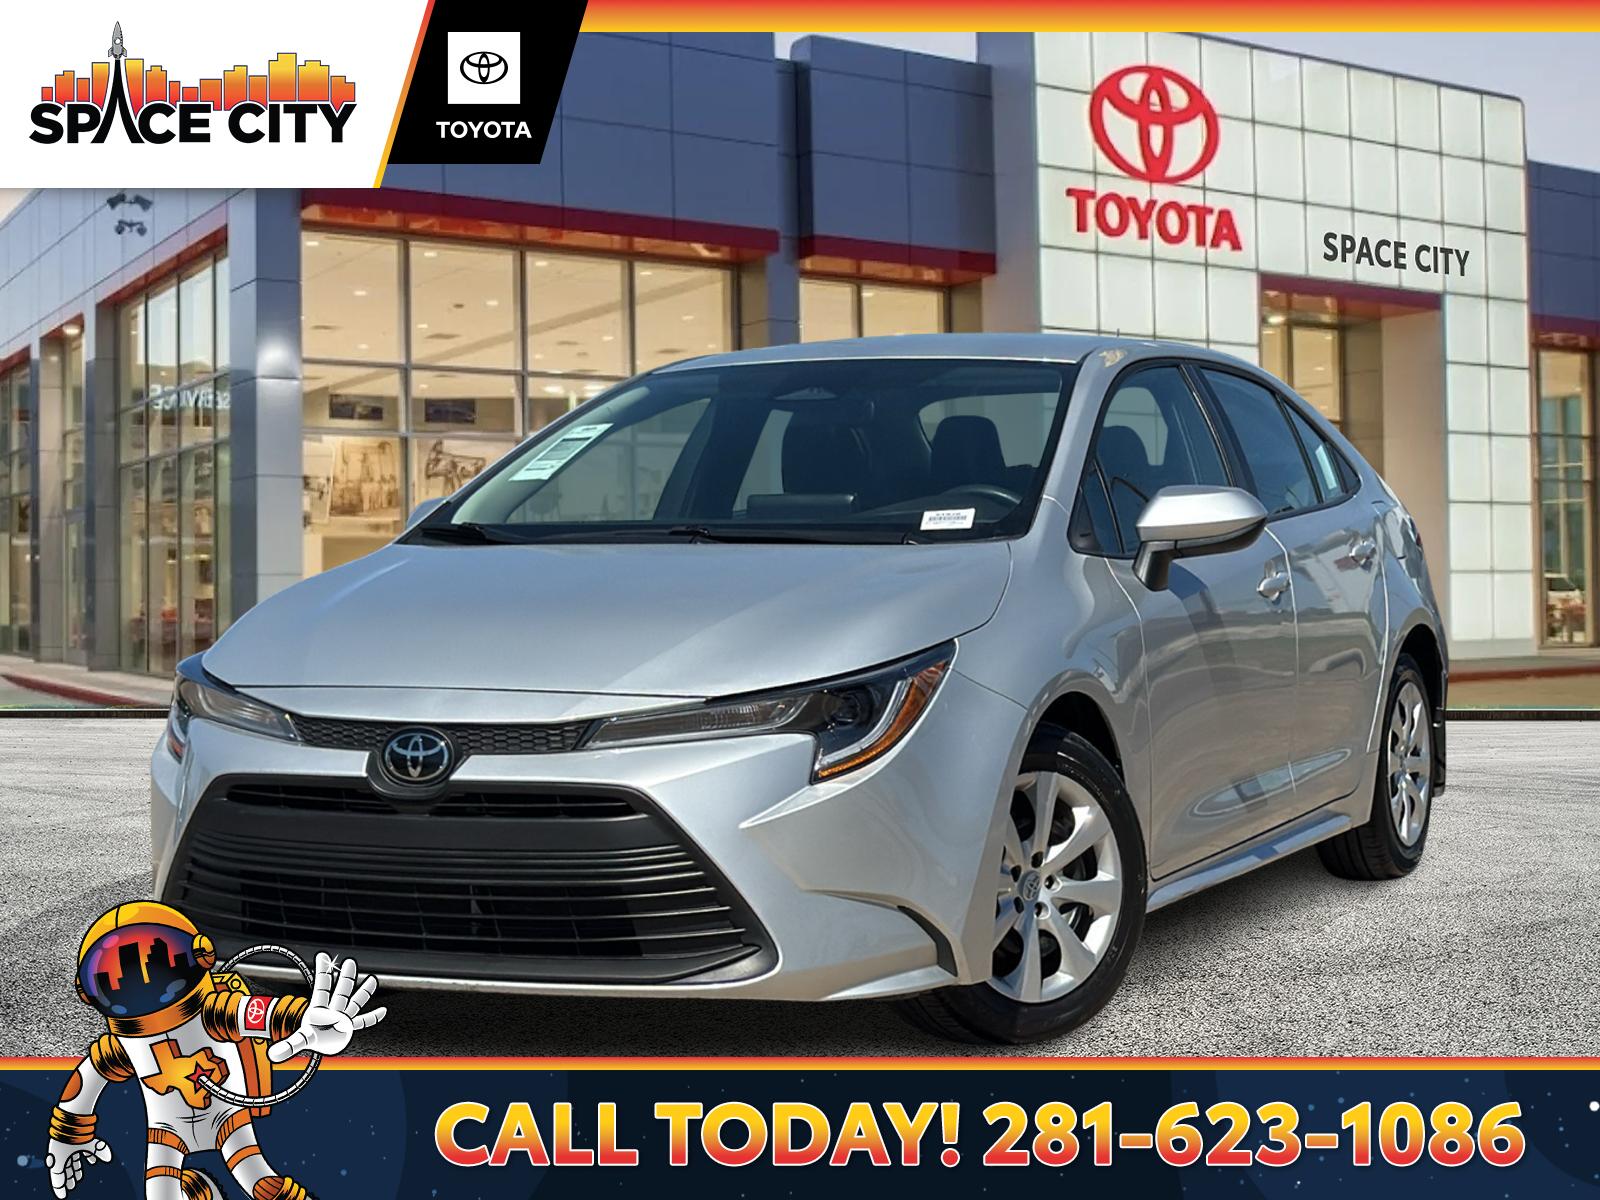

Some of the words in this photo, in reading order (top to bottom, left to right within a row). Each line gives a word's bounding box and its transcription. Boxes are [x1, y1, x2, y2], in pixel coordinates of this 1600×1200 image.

[1066, 188, 1242, 251] TOYOTA
[1323, 232, 1407, 270] SPACE
[1415, 244, 1470, 277] CITY
